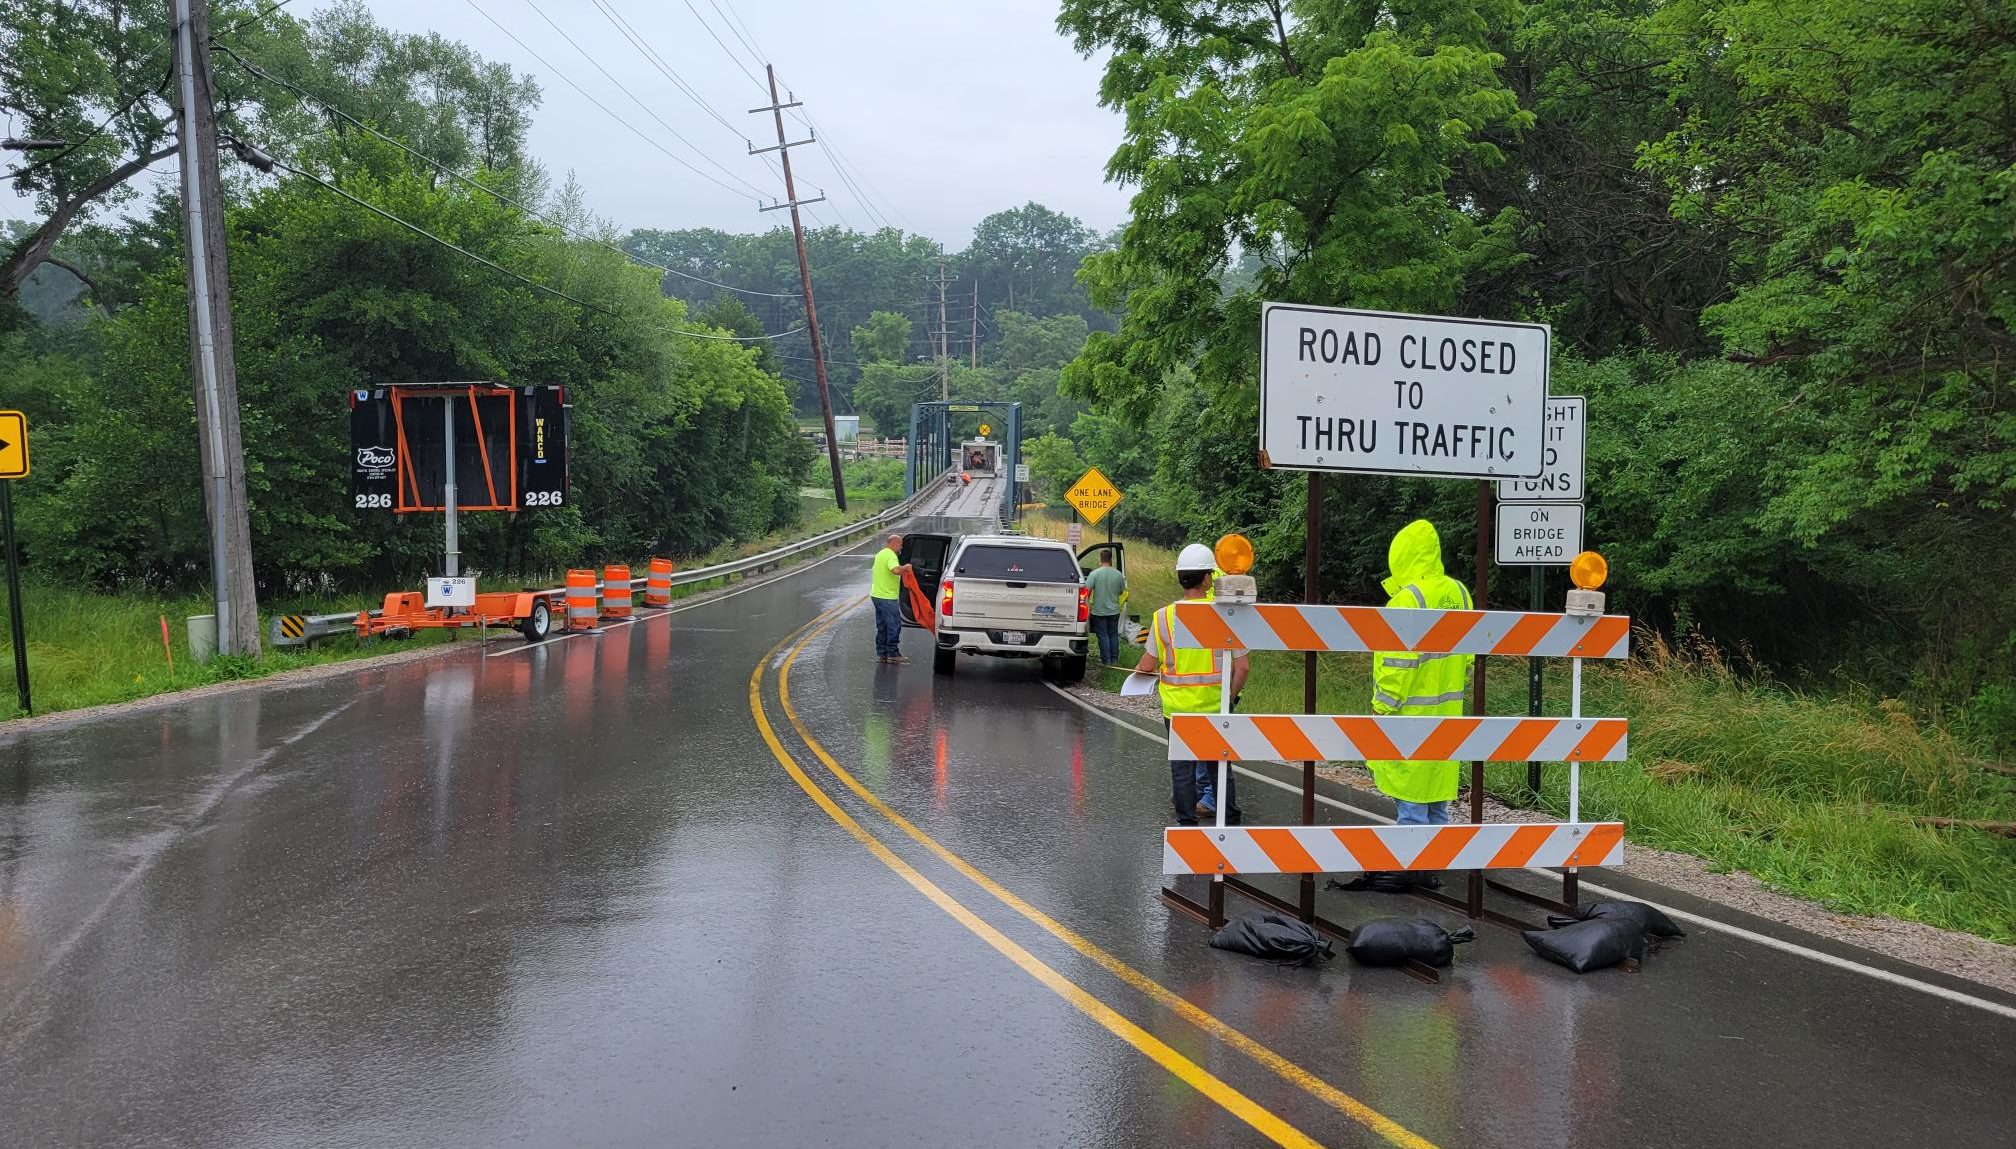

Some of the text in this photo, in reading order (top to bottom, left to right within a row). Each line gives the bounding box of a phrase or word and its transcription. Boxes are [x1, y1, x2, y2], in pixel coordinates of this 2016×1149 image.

[1299, 327, 1516, 375] ROAD CLOSED
[1394, 380, 1423, 410] TO
[535, 418, 545, 459] WANCO
[1297, 415, 1515, 460] THRU TRAFFIC
[361, 450, 392, 464] Poco
[525, 491, 563, 506] 226
[1073, 488, 1113, 497] ONE LANE
[355, 493, 392, 508] 226
[1079, 500, 1108, 509] BRIDGE
[1530, 511, 1549, 522] ON
[1514, 528, 1565, 540] BRIDGE
[1515, 546, 1563, 557] AHEAD
